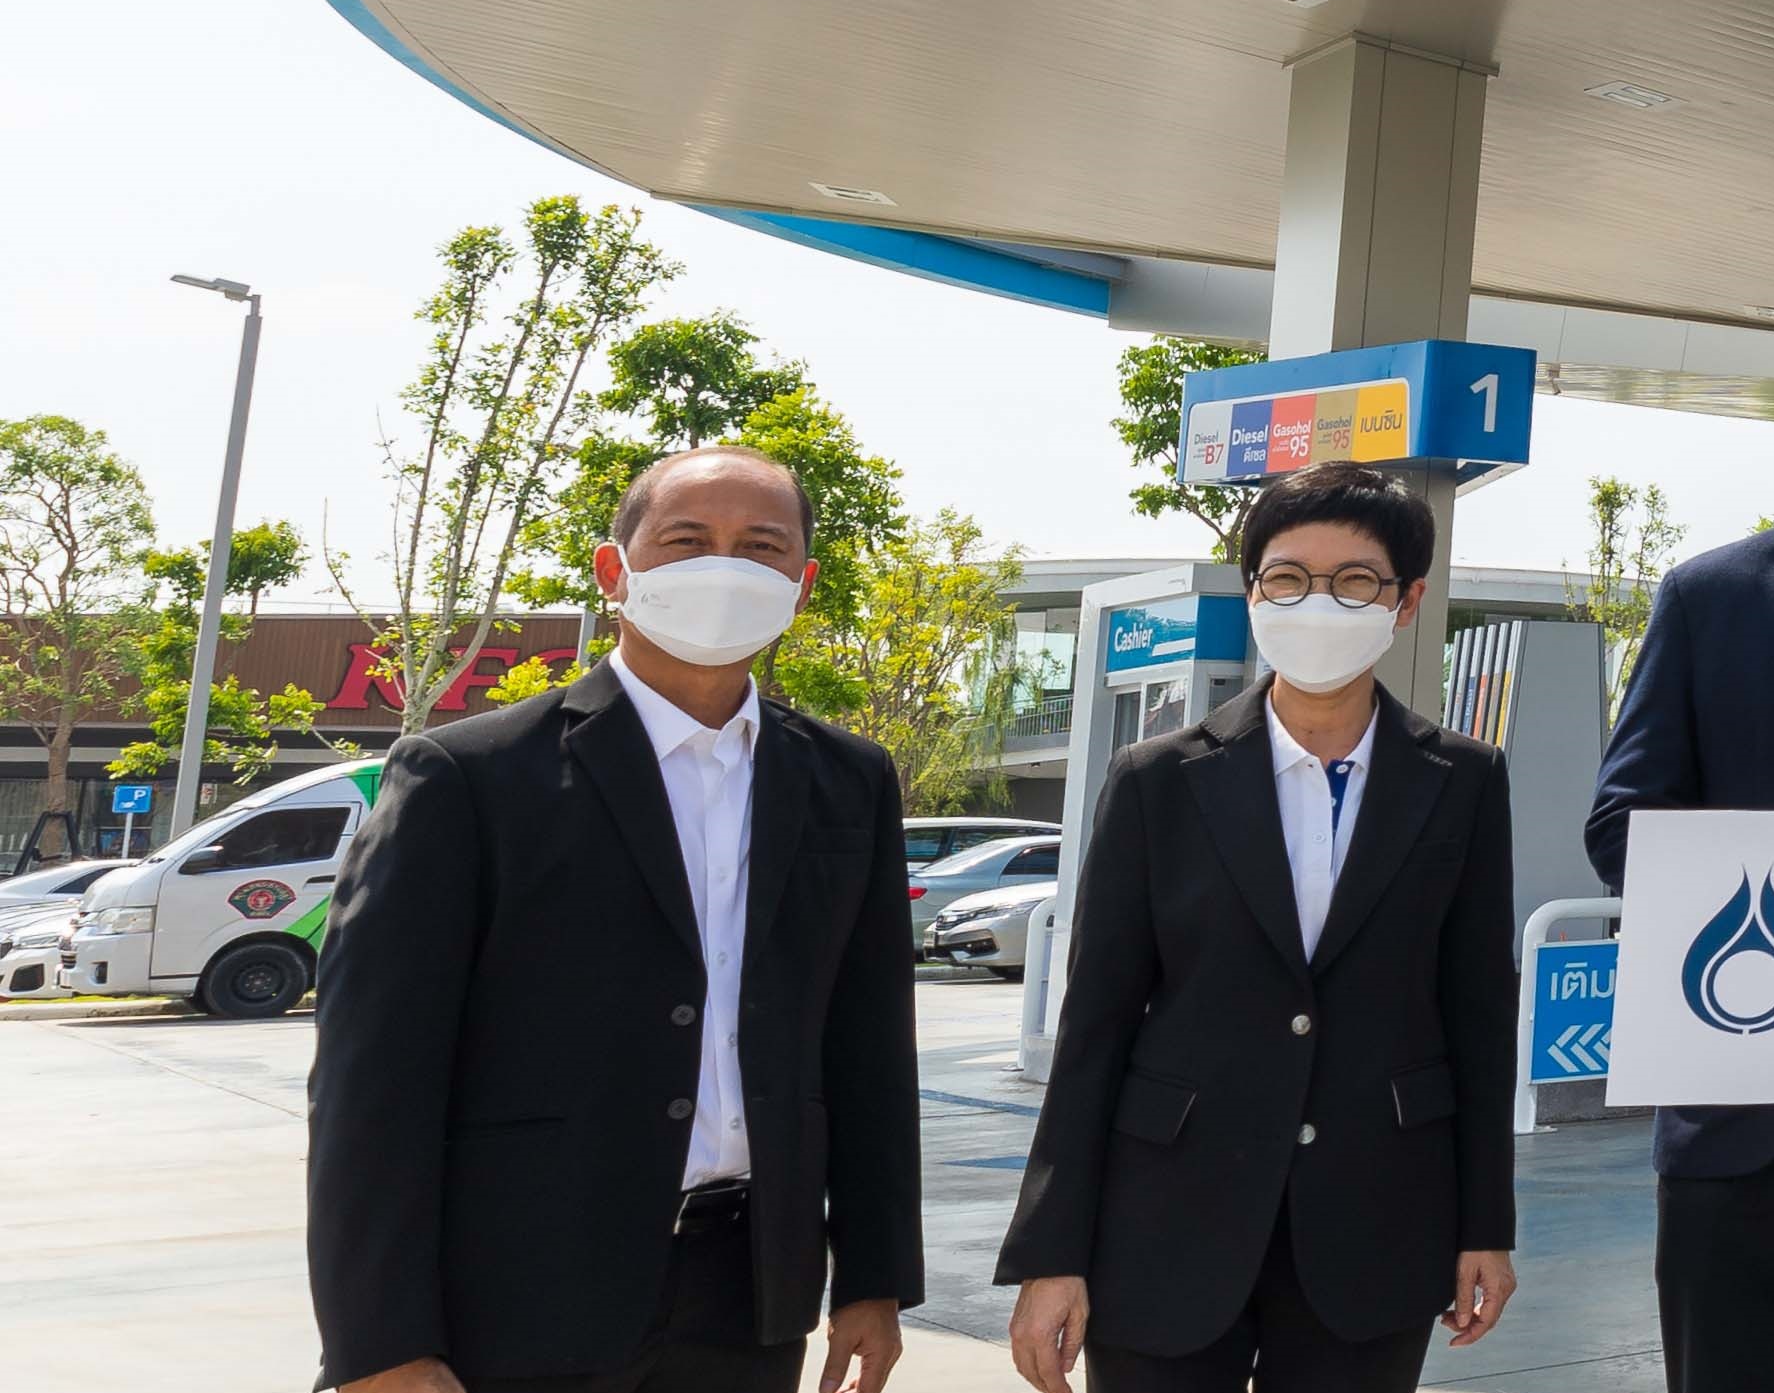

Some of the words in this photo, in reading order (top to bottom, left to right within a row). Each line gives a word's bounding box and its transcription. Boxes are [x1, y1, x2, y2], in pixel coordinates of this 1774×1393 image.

[1469, 373, 1499, 433] 1
[1273, 419, 1312, 437] Gasohol
[1317, 415, 1353, 431] Gasohol
[1194, 429, 1219, 445] Diesel
[1231, 424, 1269, 446] Diesel
[1332, 429, 1351, 450] 95
[1205, 444, 1224, 465] B7
[1289, 435, 1310, 459] 95
[1114, 623, 1154, 653] Cashier
[134, 789, 146, 801] P
